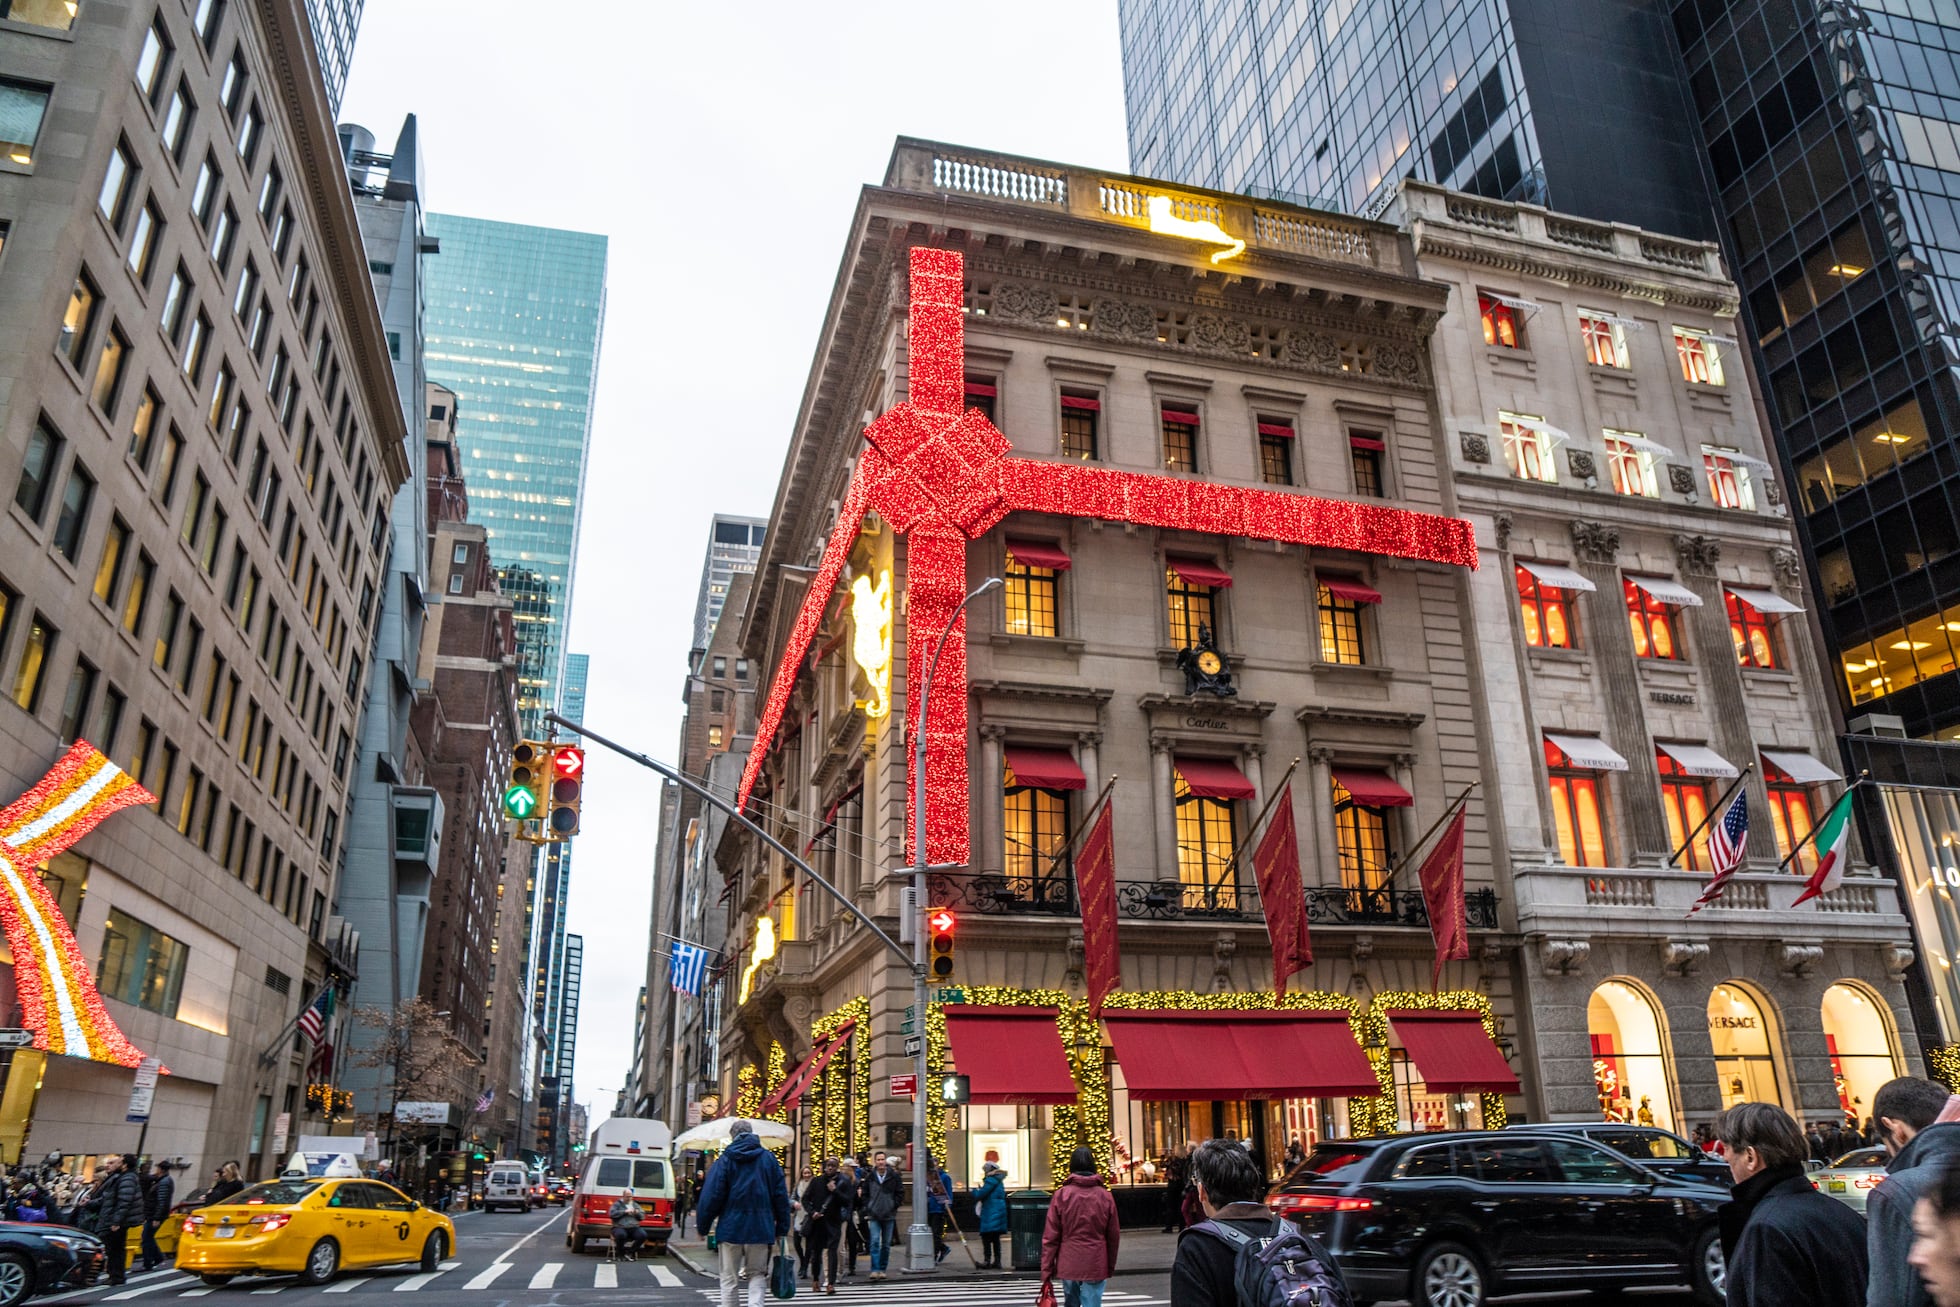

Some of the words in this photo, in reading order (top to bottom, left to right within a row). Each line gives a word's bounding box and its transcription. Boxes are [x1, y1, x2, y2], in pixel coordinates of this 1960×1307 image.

[1649, 691, 1697, 705] VERSACE
[1186, 716, 1229, 730] Cartier
[1582, 759, 1618, 768] VERSACE
[1694, 766, 1729, 776] VERSACE
[442, 767, 465, 907] BERKSHIRE
[1931, 866, 1960, 887] LO
[431, 921, 448, 1001] PLACE
[940, 990, 949, 1001] 5
[10, 1034, 28, 1042] WAY
[1003, 1094, 1037, 1104] Cartier
